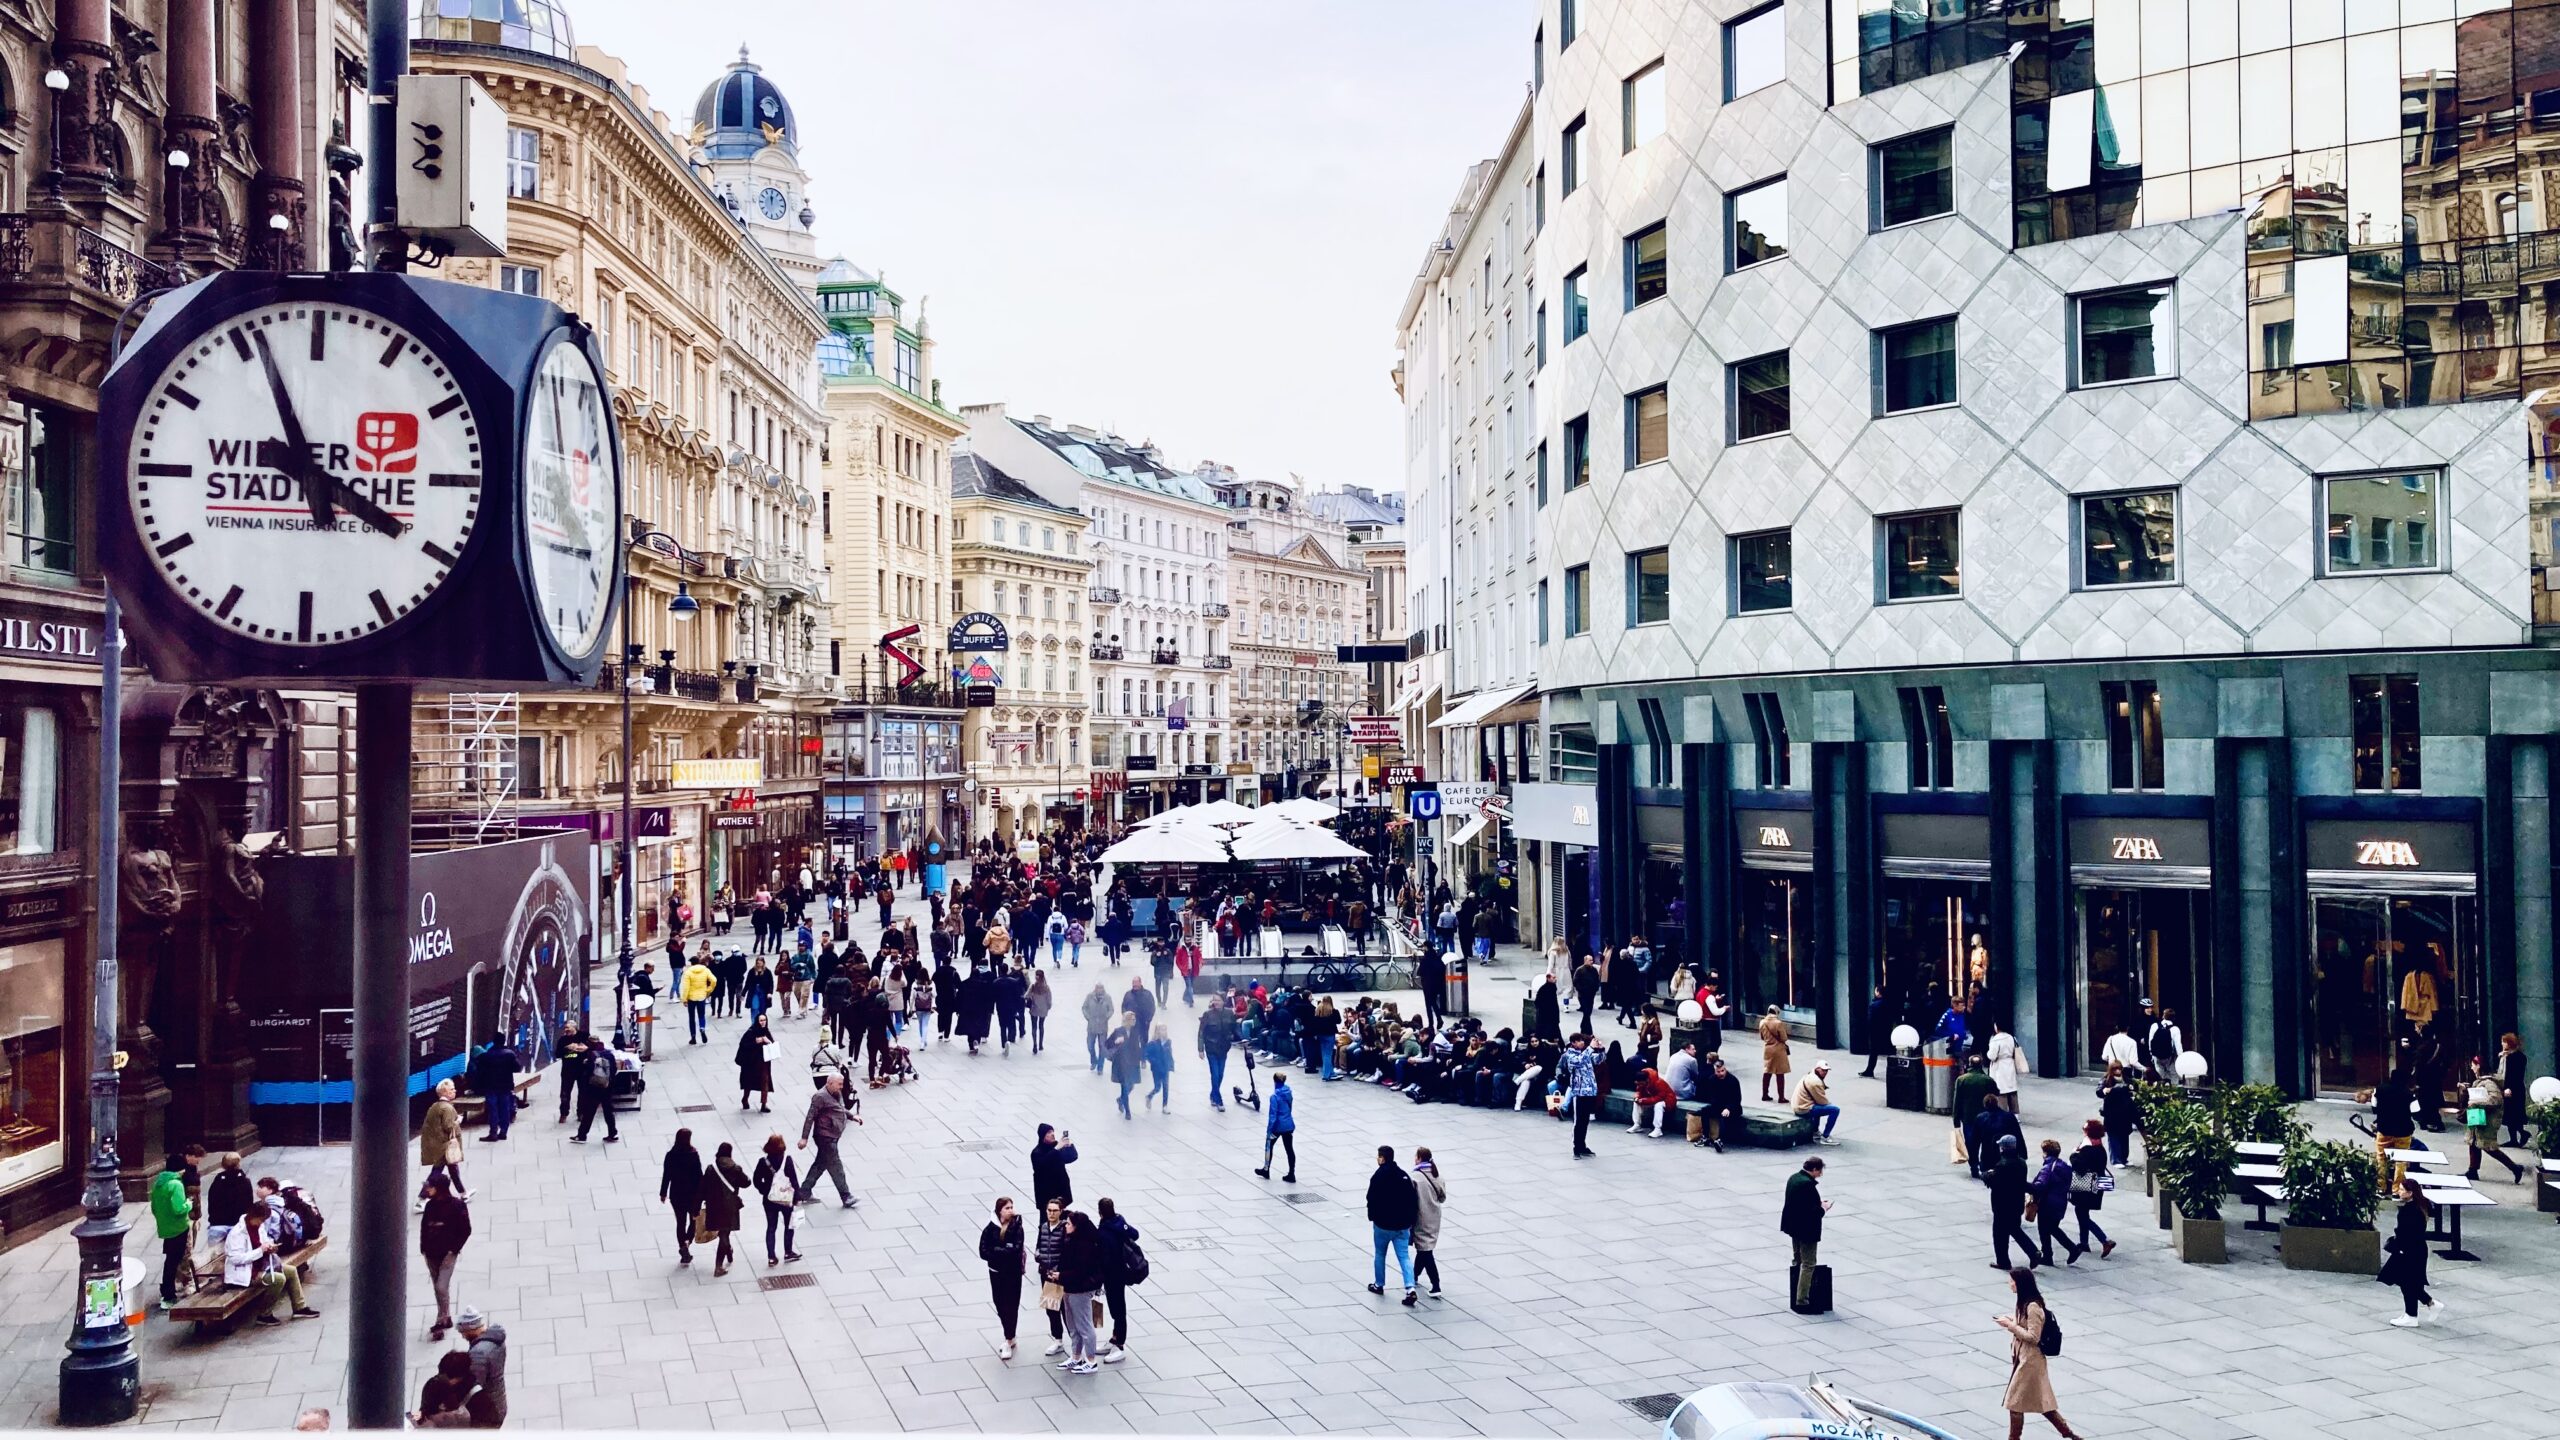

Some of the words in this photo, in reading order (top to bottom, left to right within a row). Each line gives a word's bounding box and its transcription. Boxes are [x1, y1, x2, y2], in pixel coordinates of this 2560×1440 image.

[206, 516, 264, 529] VIENNA
[0, 617, 97, 657] ILSTL
[962, 636, 995, 644] BUFFET
[1390, 767, 1414, 776] FIVE
[1387, 776, 1418, 785] GUYS
[1445, 786, 1470, 795] CAFÉ
[1475, 786, 1488, 794] DE
[1418, 797, 1437, 816] U
[716, 816, 754, 826] APOTHEKE
[1417, 838, 1433, 847] WC
[2112, 837, 2164, 860] ZARA
[2355, 840, 2420, 866] ZARA
[249, 1018, 312, 1027] BURGHARDT
[1811, 1423, 1884, 1440] MOZART
